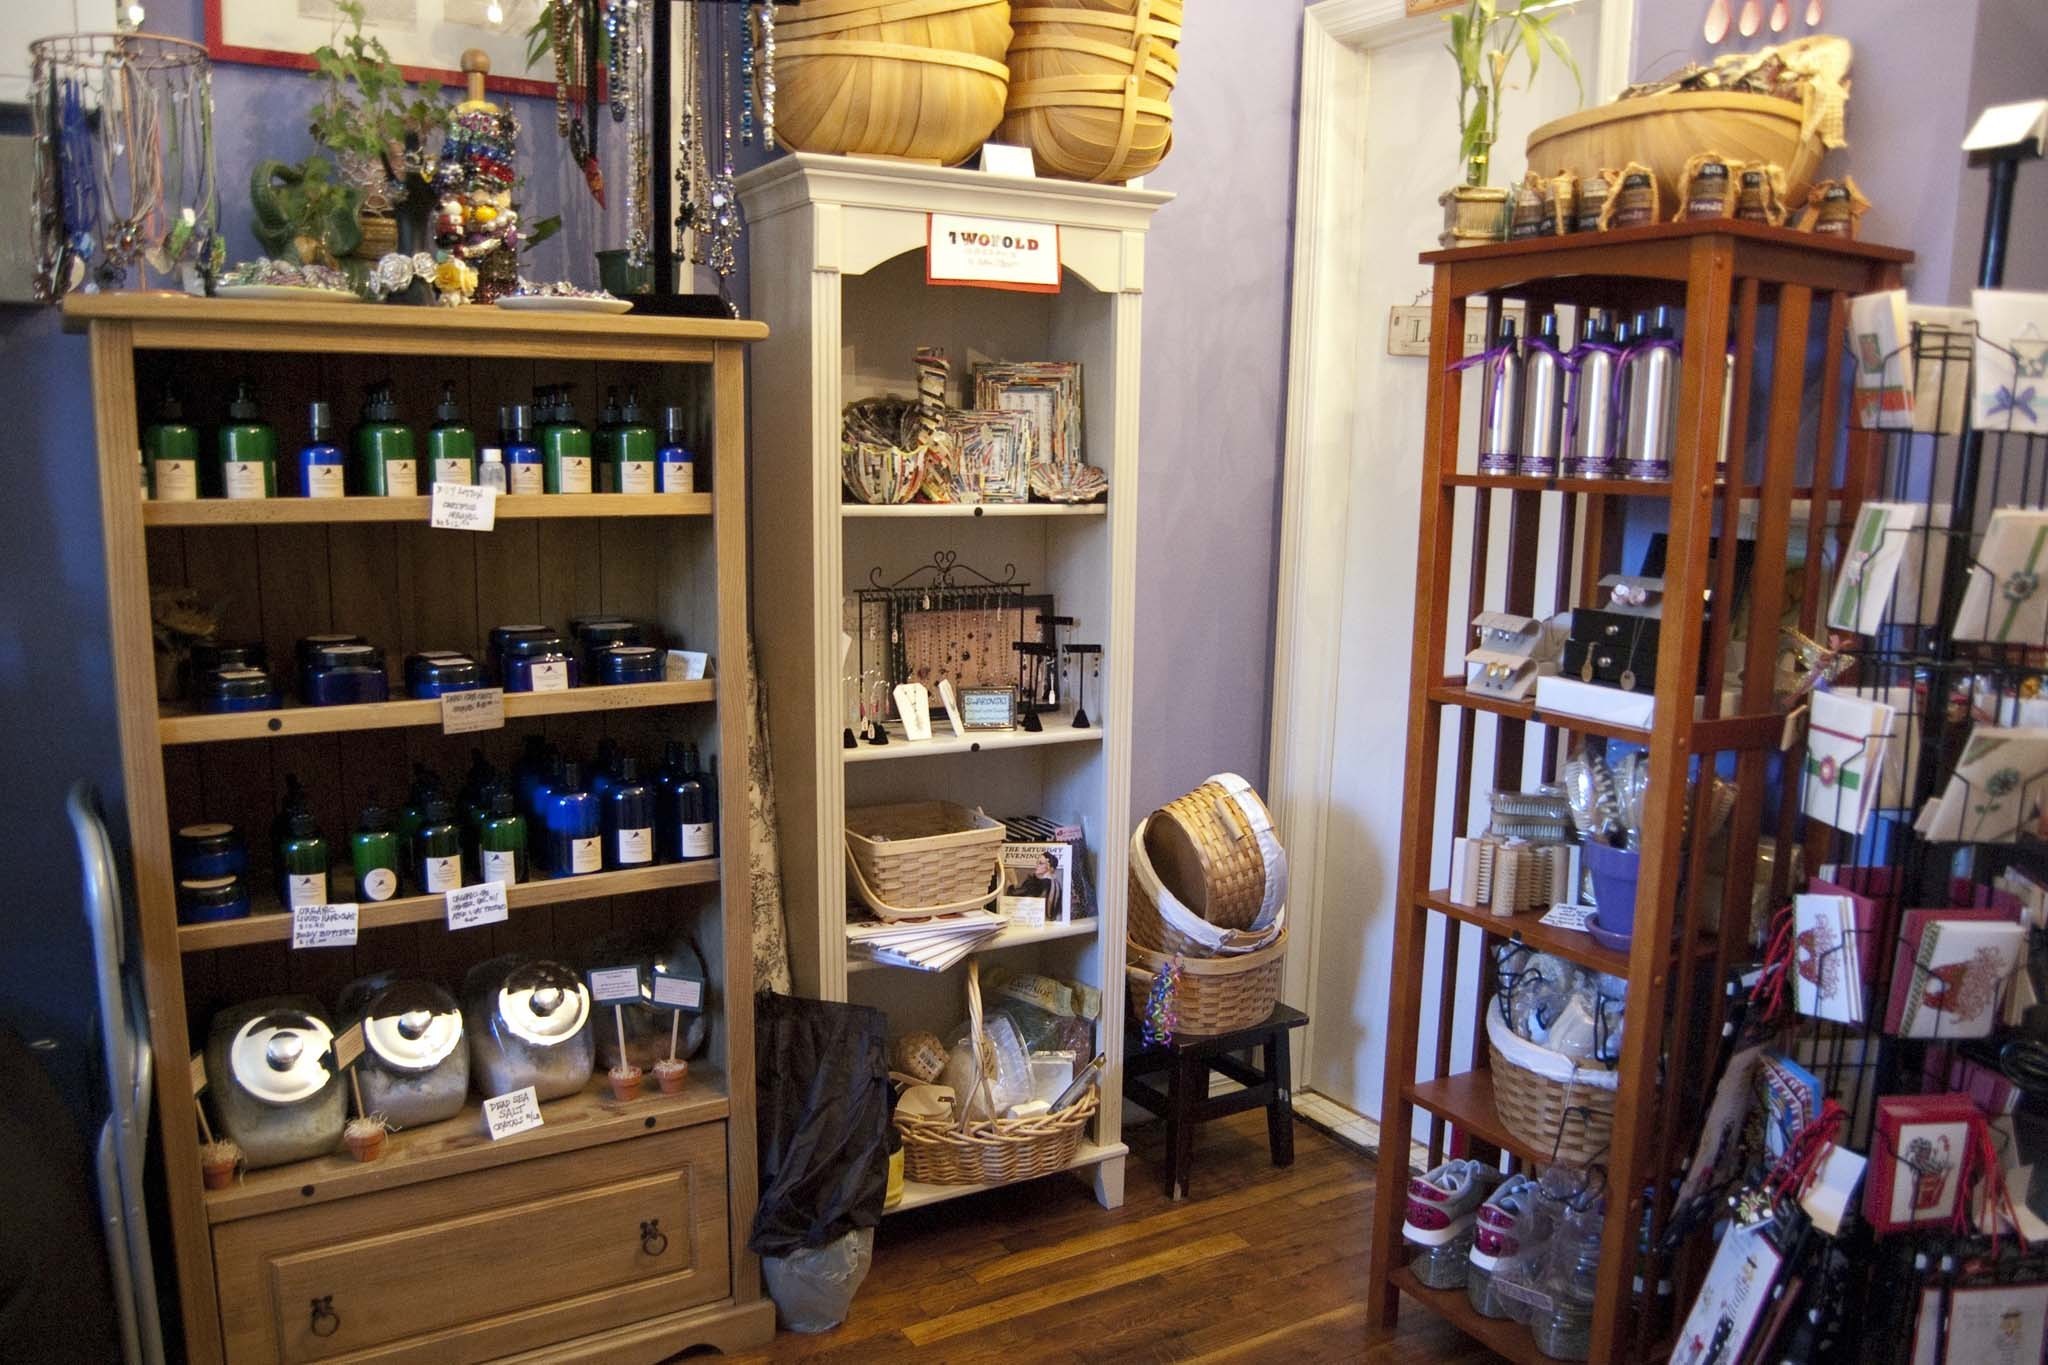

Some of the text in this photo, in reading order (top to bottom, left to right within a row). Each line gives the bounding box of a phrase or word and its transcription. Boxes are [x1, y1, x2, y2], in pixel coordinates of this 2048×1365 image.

[1004, 846, 1020, 854] THE
[489, 1092, 529, 1111] DEAD SEA
[499, 1103, 526, 1119] SALT
